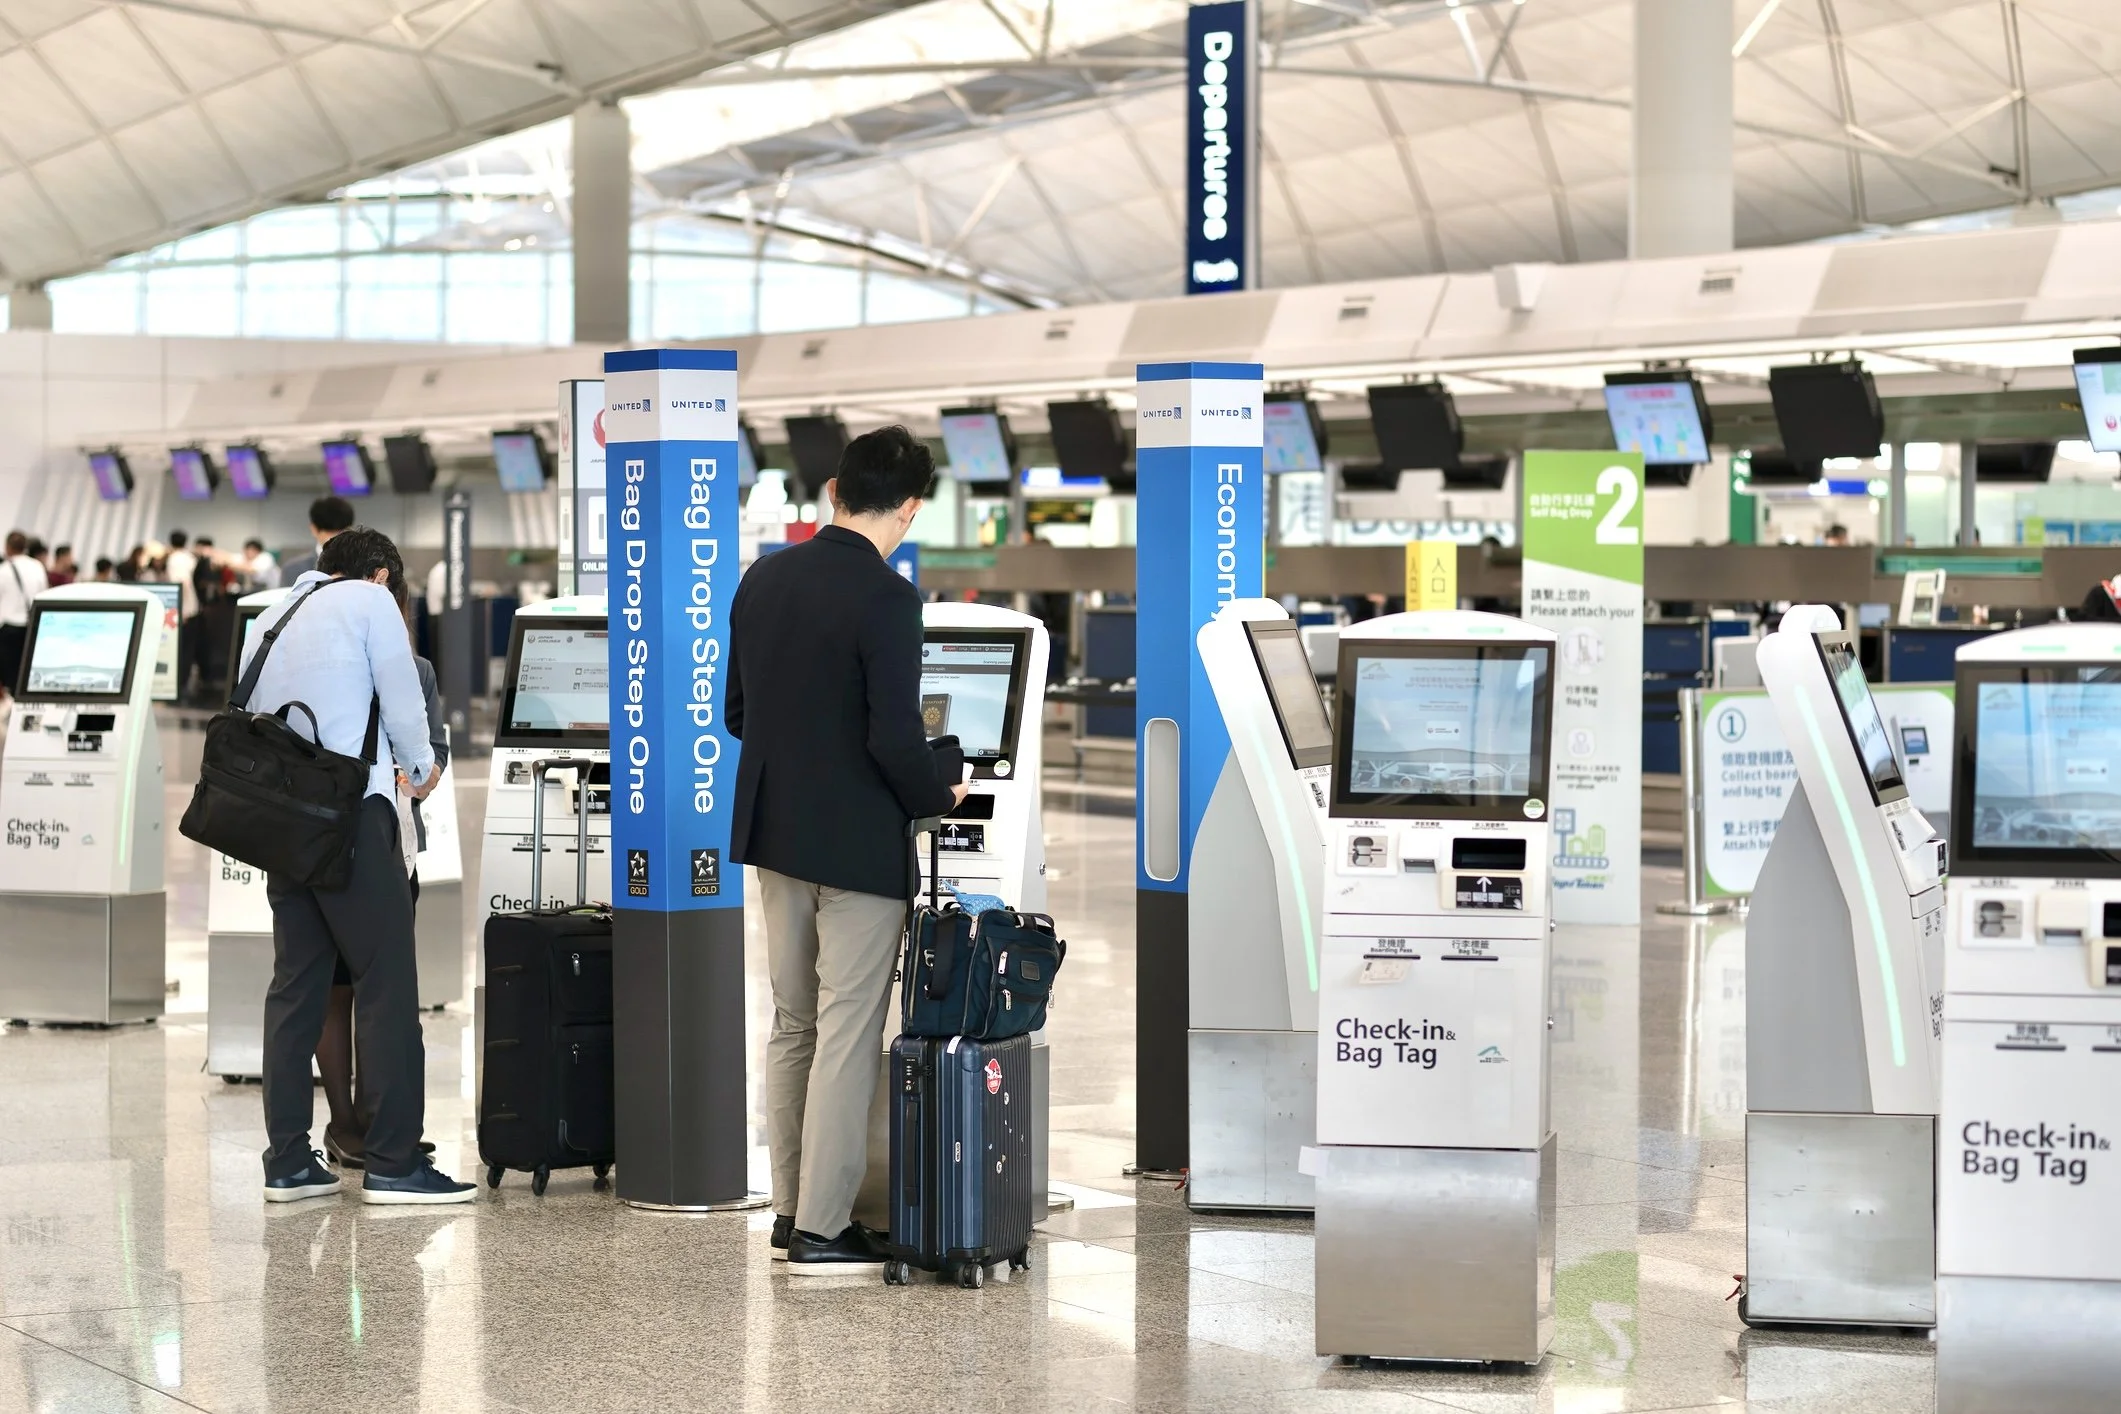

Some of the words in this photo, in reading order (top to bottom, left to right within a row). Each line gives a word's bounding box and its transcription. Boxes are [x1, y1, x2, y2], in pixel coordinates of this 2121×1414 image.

[1198, 30, 1233, 241] Departures
[611, 402, 641, 412] UNITED
[671, 400, 713, 409] UNITED
[1201, 408, 1239, 417] UNITED
[1143, 409, 1173, 418] UNITED
[620, 459, 645, 531] Bag
[683, 458, 717, 529] Bag
[1530, 507, 1549, 518] Self
[1550, 507, 1569, 520] Bag
[1570, 507, 1593, 520] Drop
[1595, 465, 1639, 545] 2
[1210, 463, 1243, 621] Econom
[582, 561, 608, 572] ONLIN
[1431, 557, 1446, 593] 入口
[622, 540, 646, 632] Drop
[685, 538, 718, 631] Drop
[1530, 605, 1568, 617] Please
[1571, 605, 1607, 617] attach
[1610, 608, 1635, 620] your
[623, 638, 648, 728] Step
[686, 637, 720, 727] Step
[1566, 697, 1581, 707] Bag
[1583, 697, 1598, 707] Tag
[628, 735, 650, 815] One
[693, 734, 721, 814] One
[1721, 769, 1762, 781] Collect
[1765, 769, 1799, 780] board
[1722, 786, 1741, 797] and
[1744, 786, 1763, 799] bag
[1765, 786, 1782, 797] tag
[7, 833, 31, 849] Bag
[37, 833, 60, 850] Tag
[1723, 839, 1757, 850] Attach
[222, 867, 251, 884] Bag
[629, 886, 648, 895] GOLD
[694, 885, 717, 895] GOLD
[1335, 1042, 1383, 1068] Bag
[1393, 1042, 1438, 1070] Tag
[1962, 1151, 2020, 1183] Bag
[2033, 1151, 2088, 1185] Tag
